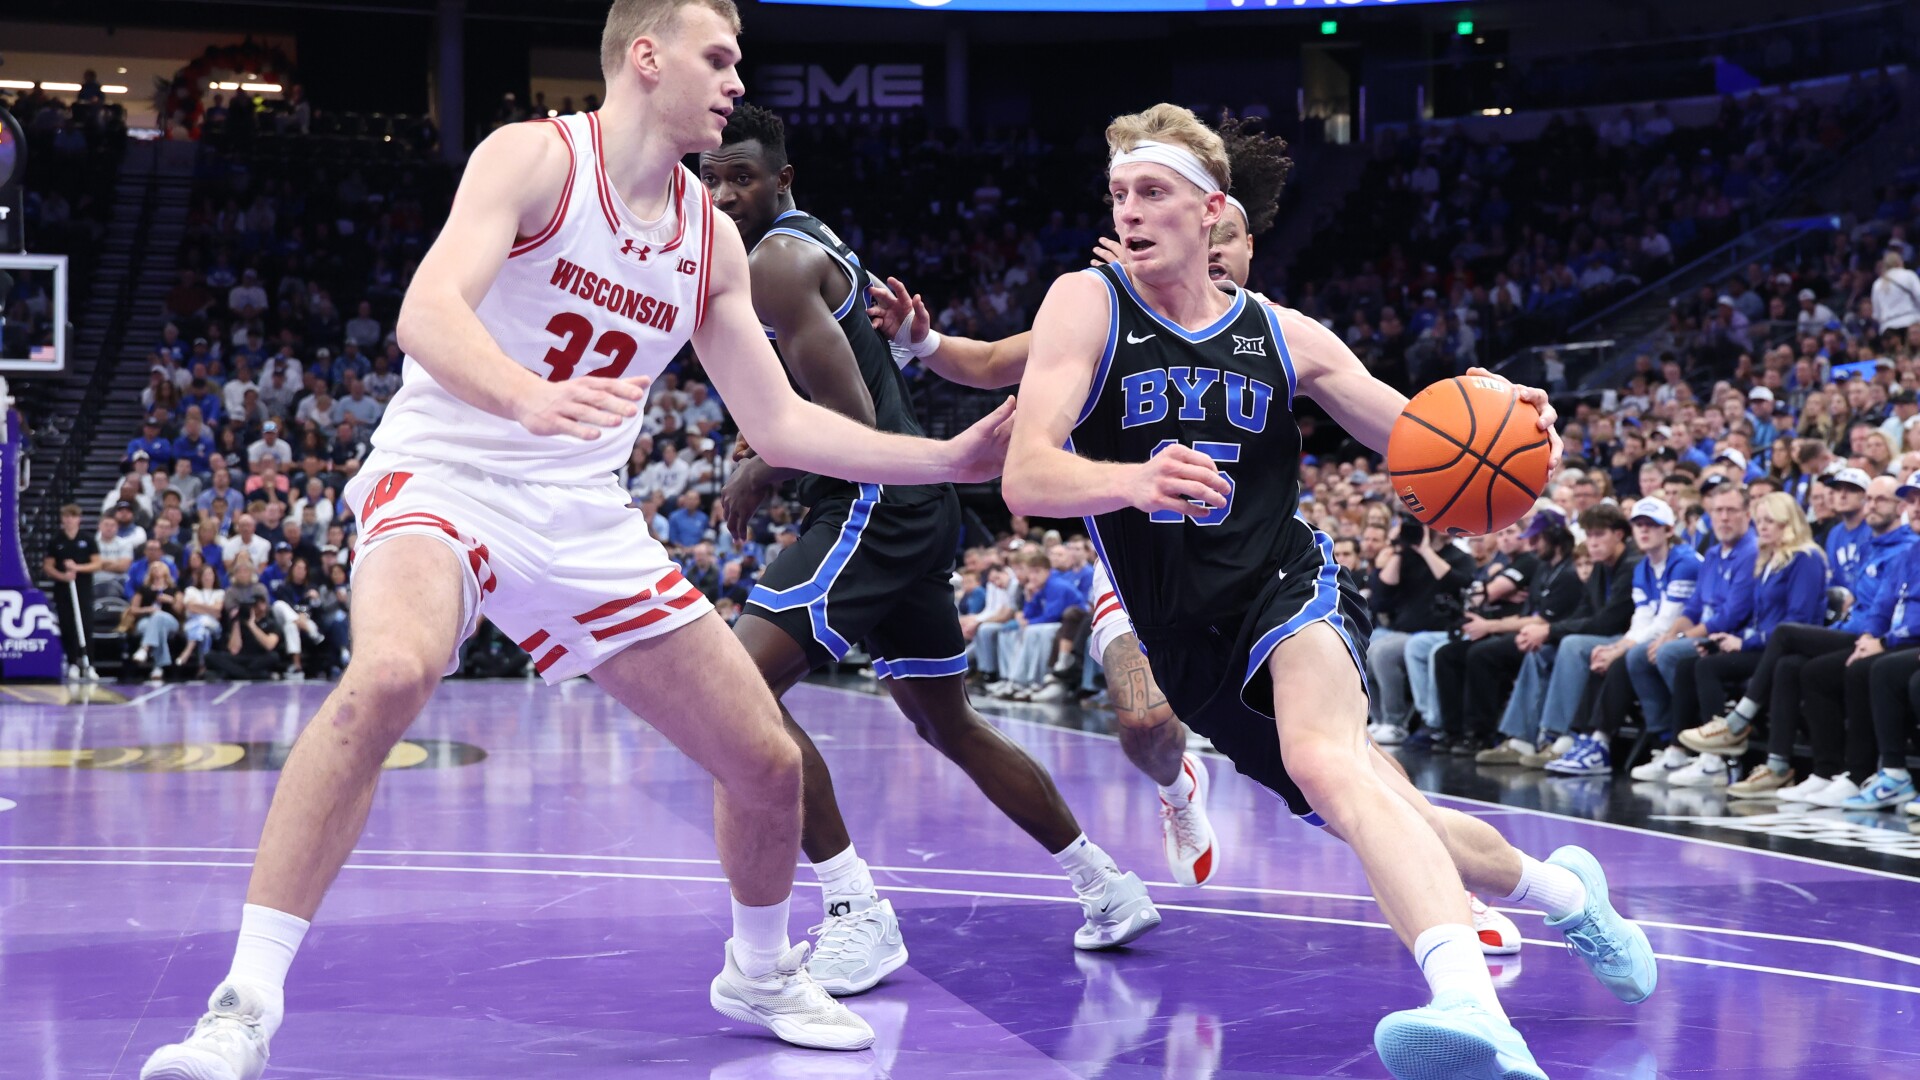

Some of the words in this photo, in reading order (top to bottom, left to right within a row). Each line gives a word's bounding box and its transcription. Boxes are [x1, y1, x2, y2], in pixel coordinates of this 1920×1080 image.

[757, 64, 922, 107] SME
[550, 258, 679, 333] WISCONSIN
[541, 311, 638, 383] 32
[1121, 366, 1274, 434] BYU
[4, 638, 48, 652] FIRST
